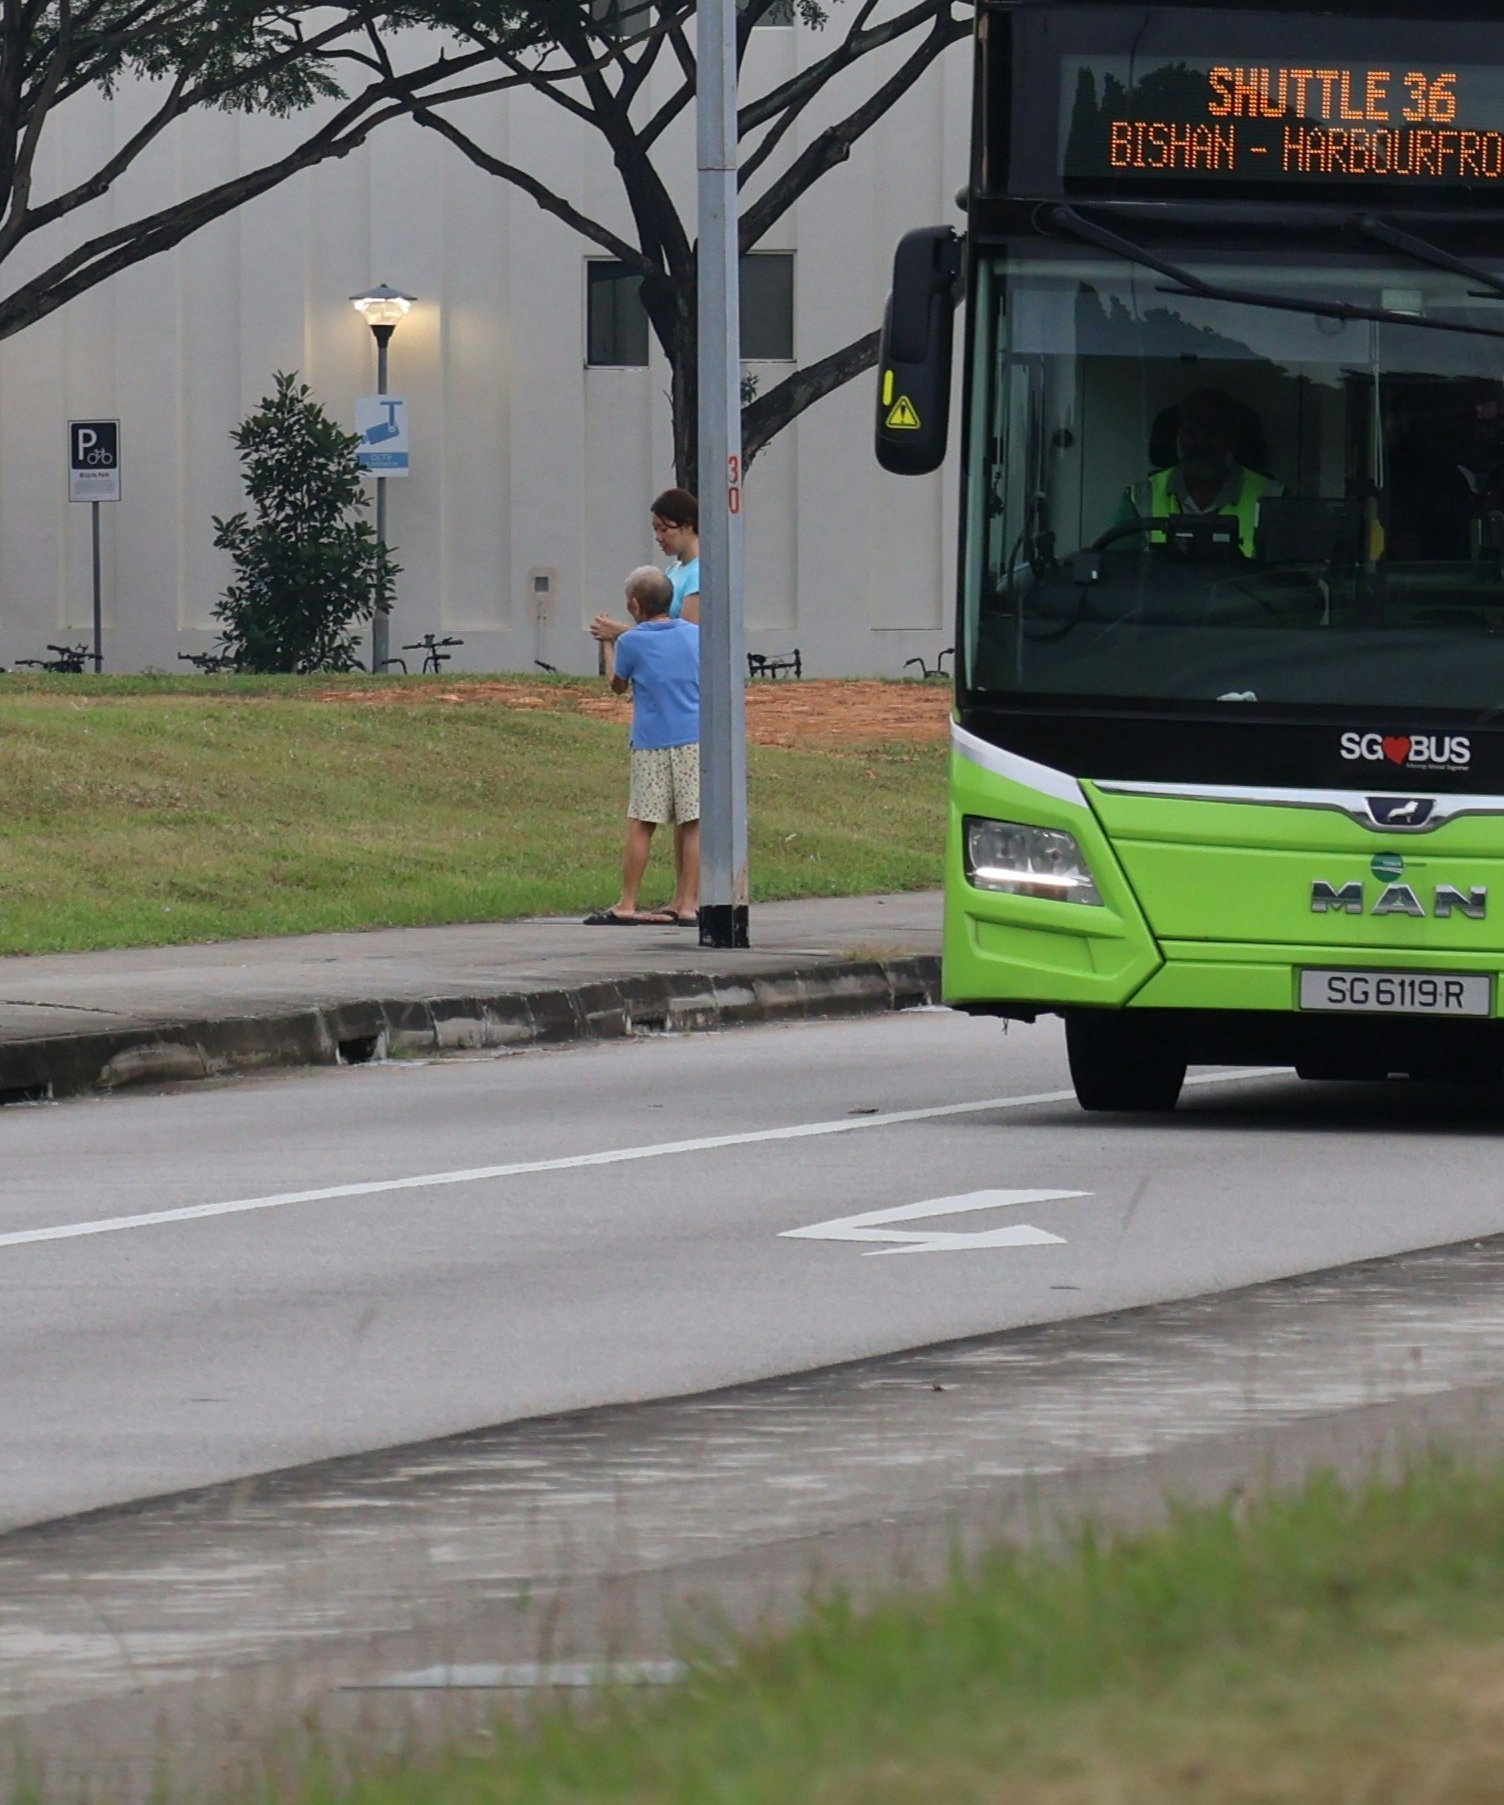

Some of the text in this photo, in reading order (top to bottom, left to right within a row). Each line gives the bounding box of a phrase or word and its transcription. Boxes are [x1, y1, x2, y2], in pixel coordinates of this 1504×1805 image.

[1208, 67, 1457, 122] SHUTTLE 36
[1110, 121, 1235, 170] BISHAN
[78, 428, 98, 461] P
[1311, 880, 1487, 920] MAN
